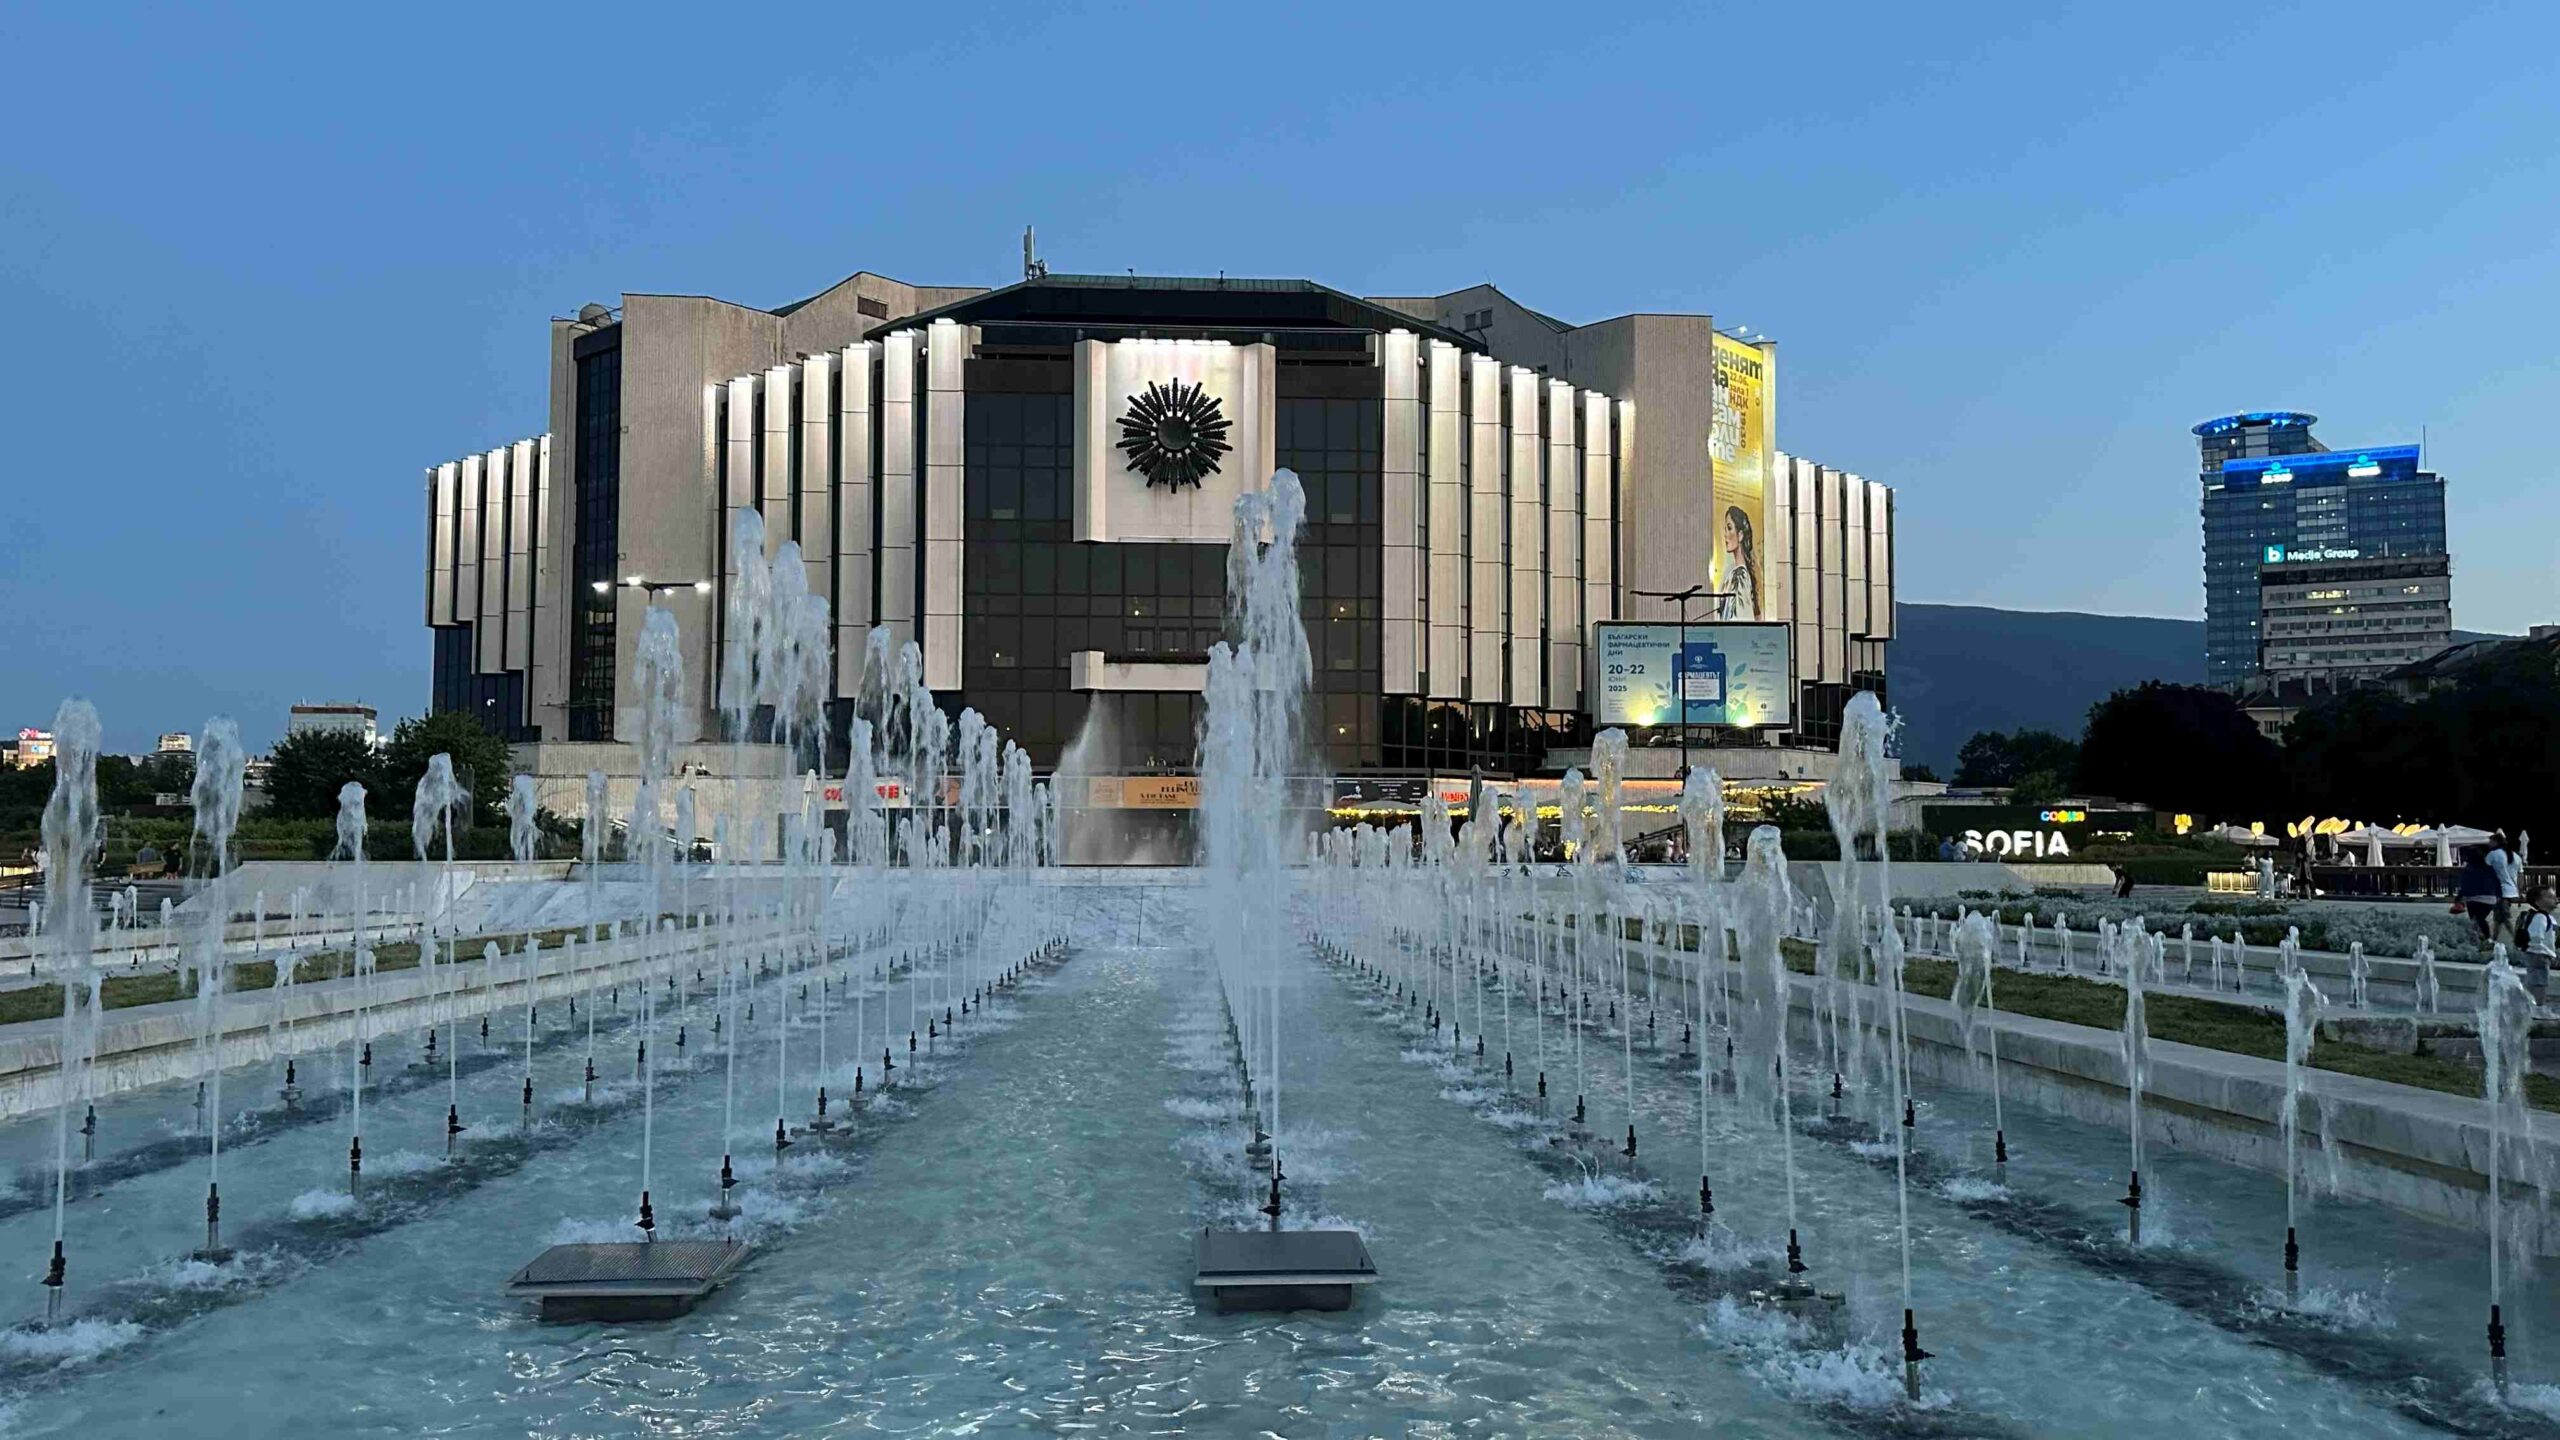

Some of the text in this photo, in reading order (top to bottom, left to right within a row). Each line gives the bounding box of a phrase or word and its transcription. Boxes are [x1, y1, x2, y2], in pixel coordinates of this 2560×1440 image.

[1729, 392, 1749, 409] НДК
[2287, 550, 2320, 560] Media
[2324, 549, 2359, 559] Group
[1965, 829, 2069, 858] SOFIA
